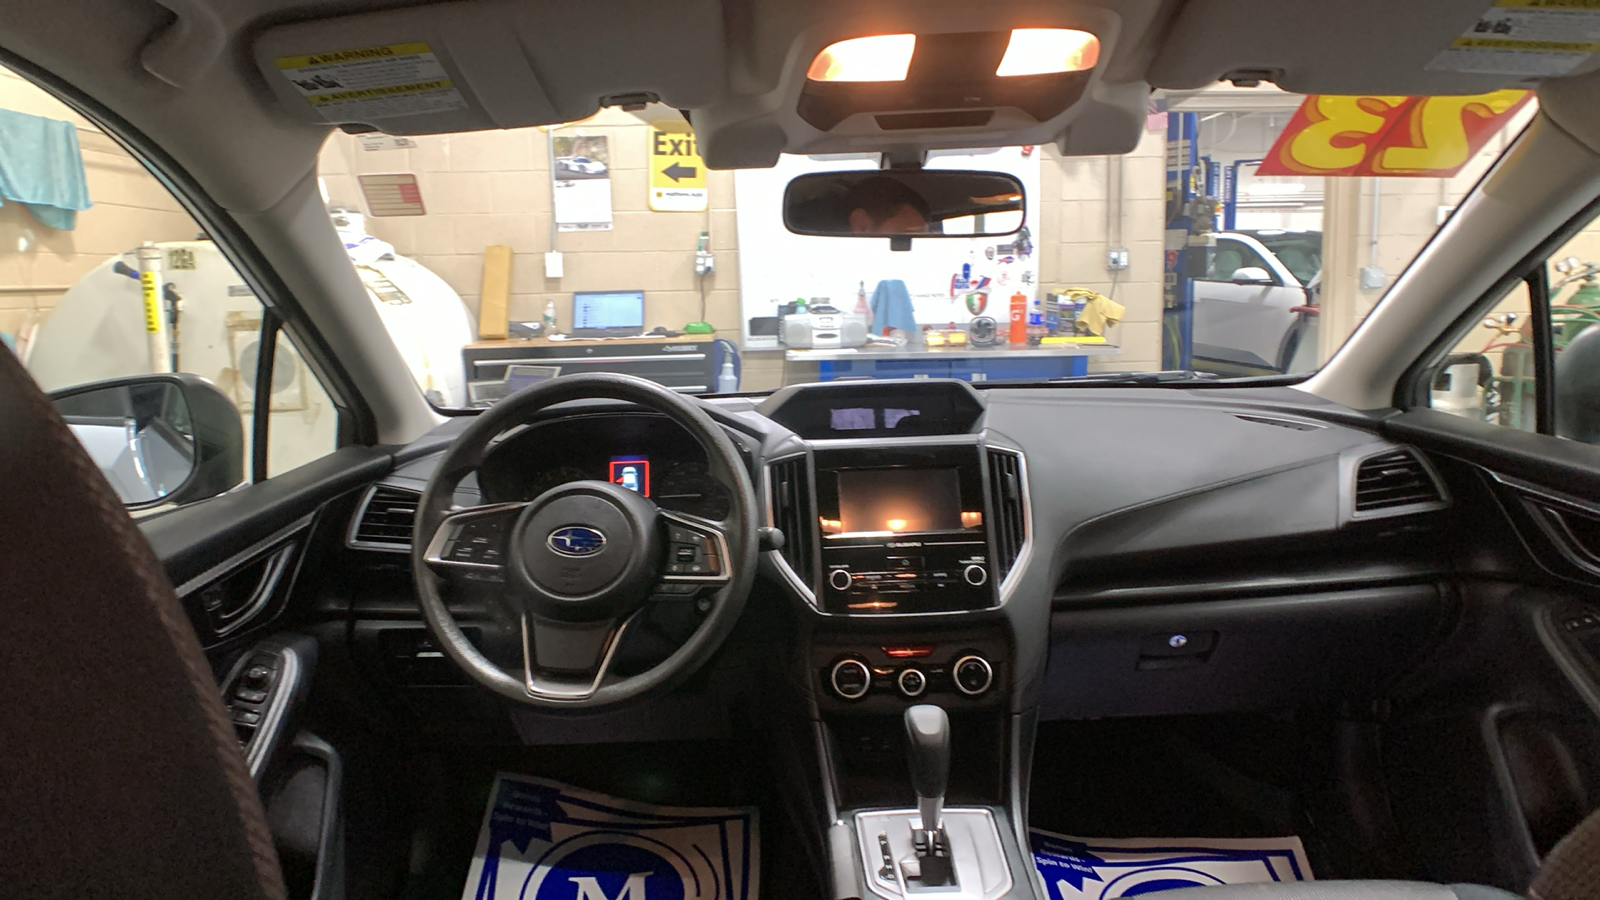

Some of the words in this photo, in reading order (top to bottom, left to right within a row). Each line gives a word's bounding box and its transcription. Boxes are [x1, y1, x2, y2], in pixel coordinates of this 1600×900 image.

[319, 46, 395, 64] WARNING
[329, 80, 443, 101] AVERTISSEMENT
[1035, 856, 1058, 867] Spin
[1070, 863, 1094, 874] Win!
